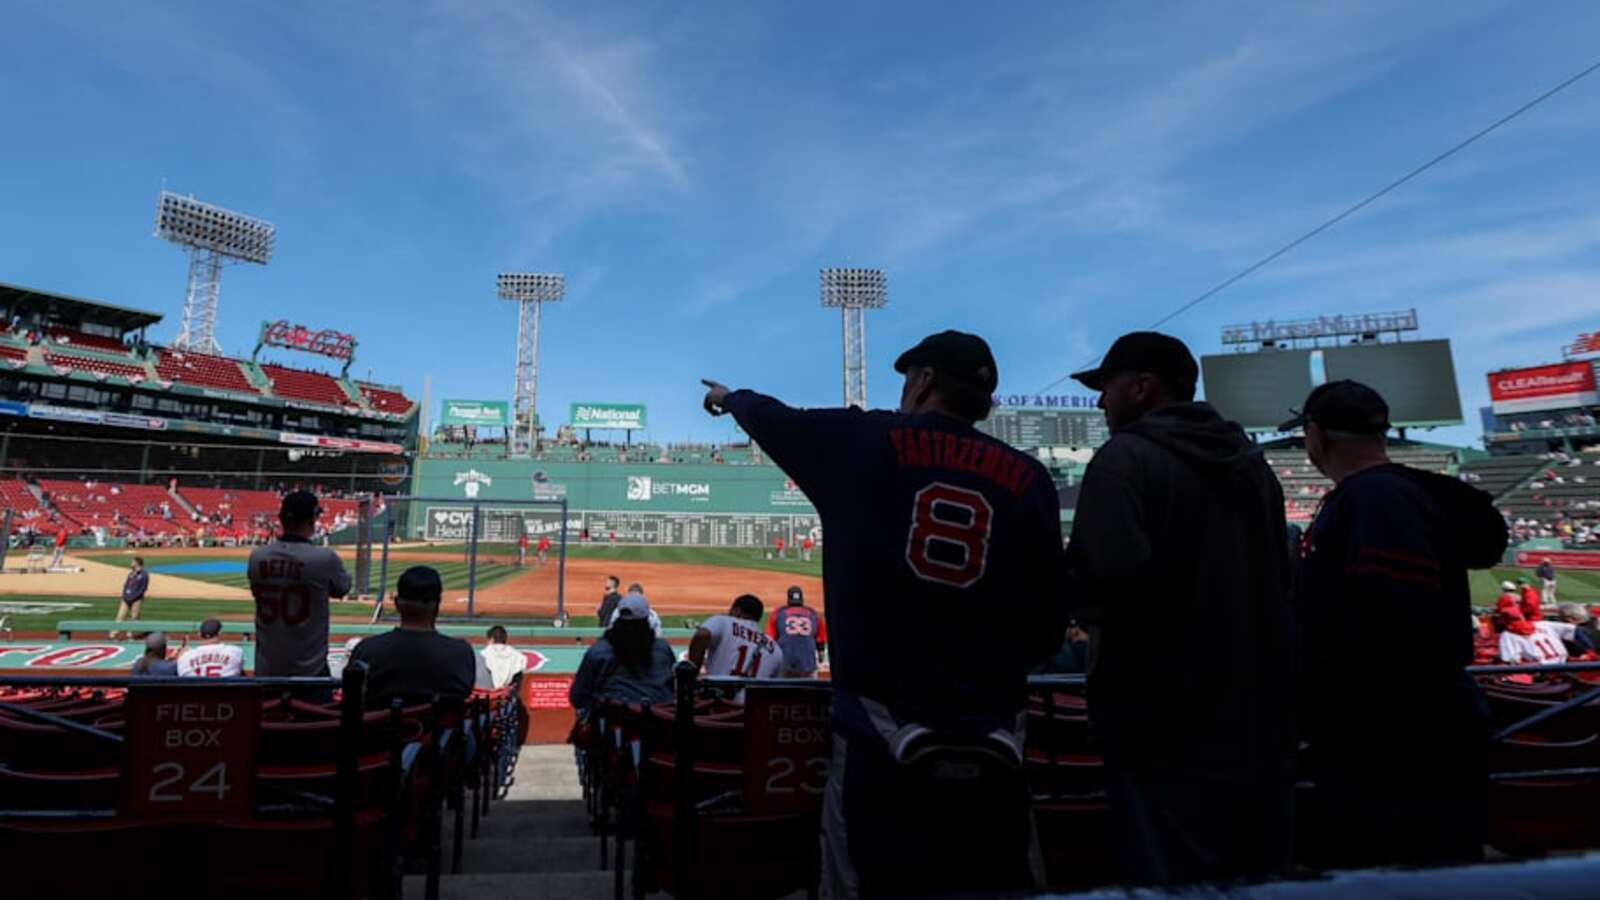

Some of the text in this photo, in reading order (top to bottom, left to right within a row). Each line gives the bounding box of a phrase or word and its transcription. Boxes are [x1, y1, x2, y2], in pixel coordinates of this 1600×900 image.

[1008, 395, 1028, 406] OF
[1033, 396, 1099, 408] AMERIC
[653, 484, 709, 495] BETMGM
[905, 481, 994, 588] 8
[785, 616, 812, 637] 33
[730, 645, 764, 677] 11
[155, 703, 234, 722] FIELD
[165, 729, 222, 748] BOX
[776, 728, 828, 745] BOX
[149, 761, 231, 801] 24
[764, 757, 832, 794] 23
